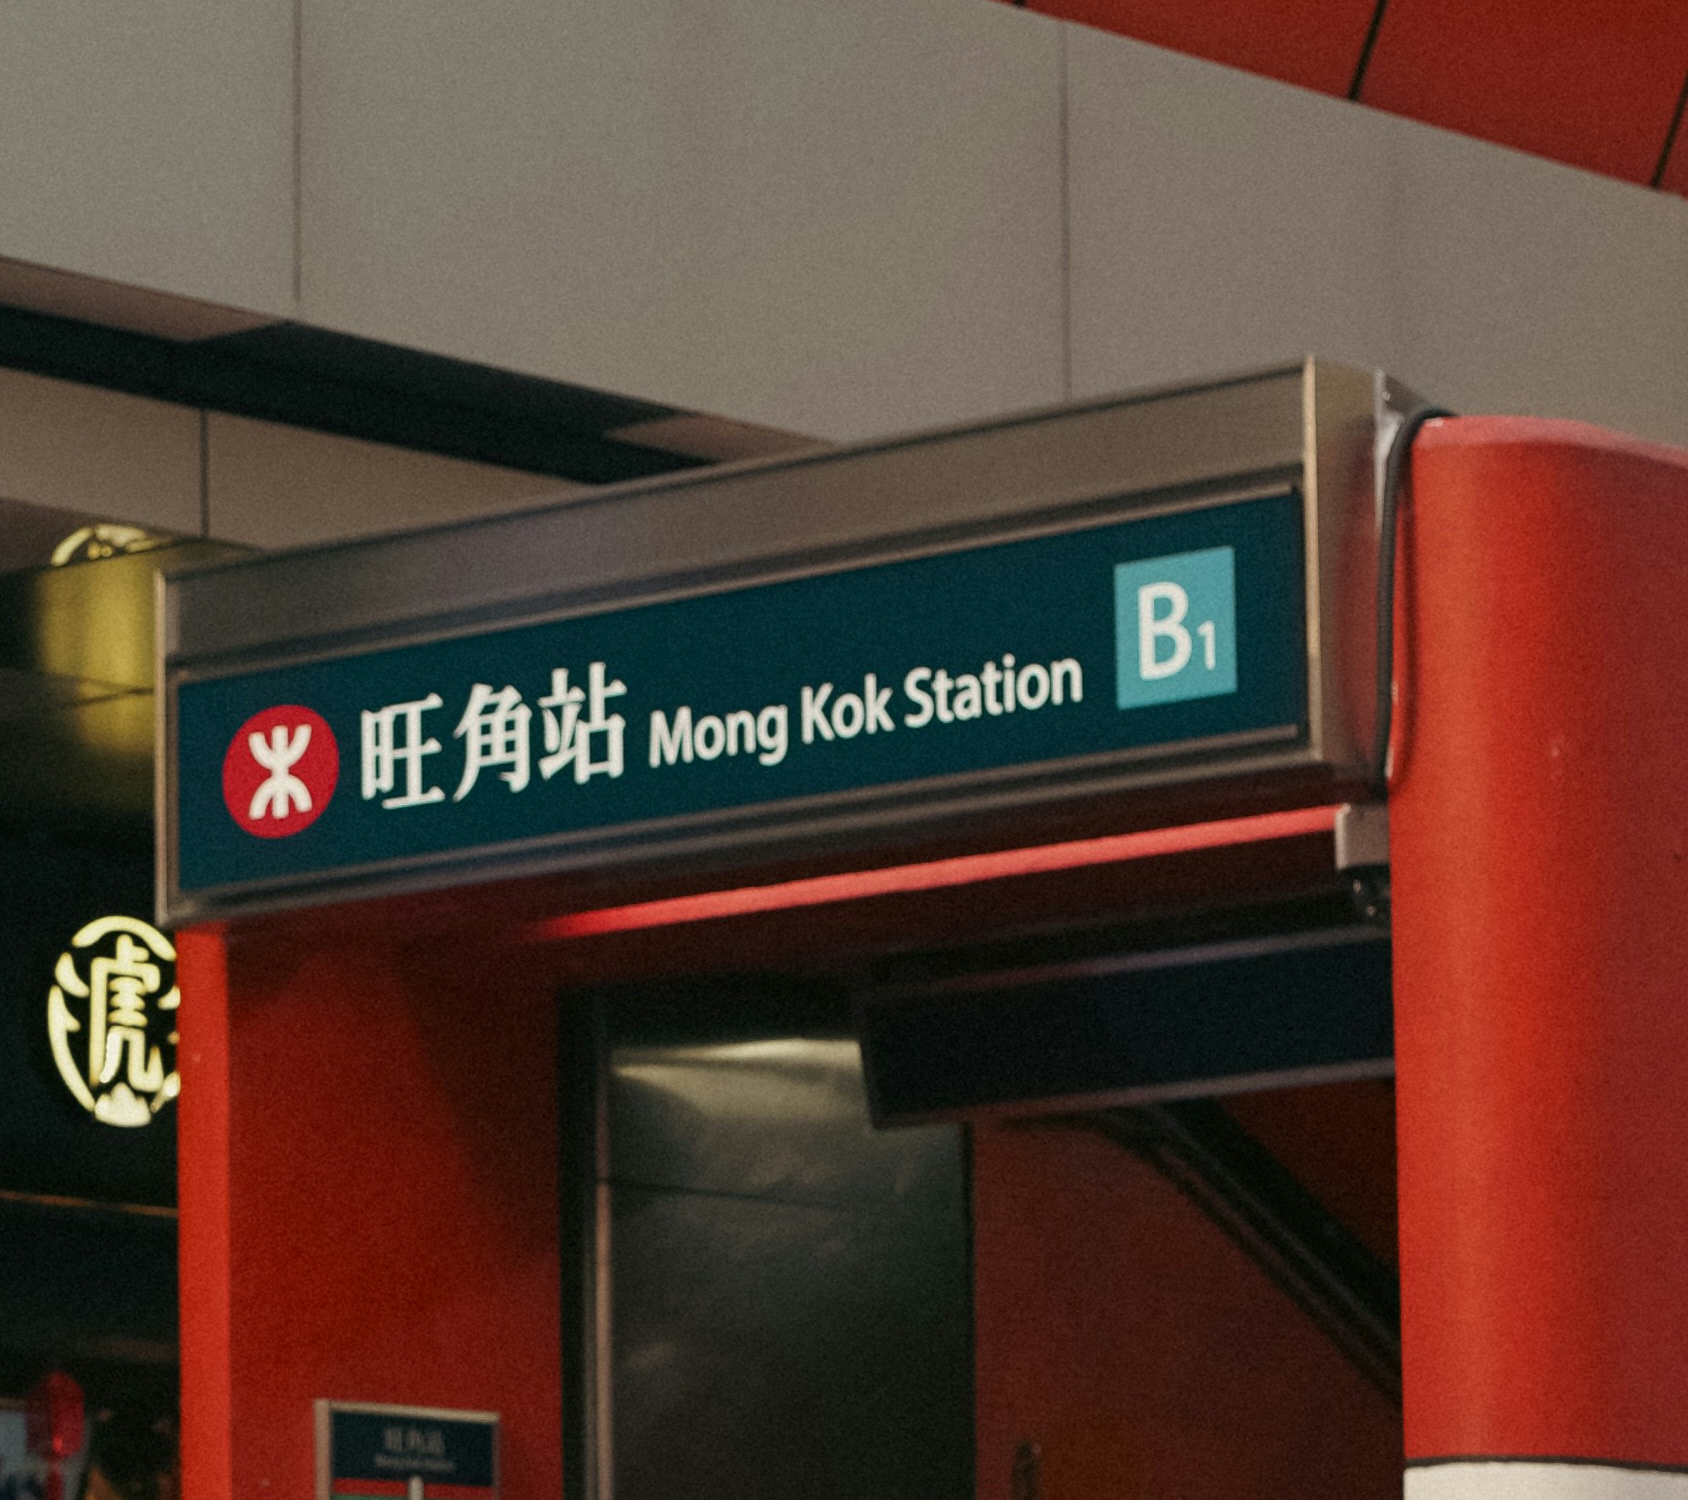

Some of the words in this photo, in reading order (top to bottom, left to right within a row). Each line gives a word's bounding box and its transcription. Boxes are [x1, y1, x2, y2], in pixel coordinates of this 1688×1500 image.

[360, 661, 627, 810] 旺角站
[649, 705, 789, 767] Mong
[801, 673, 895, 744] Kok
[904, 653, 1083, 728] Station
[1138, 581, 1216, 681] B1
